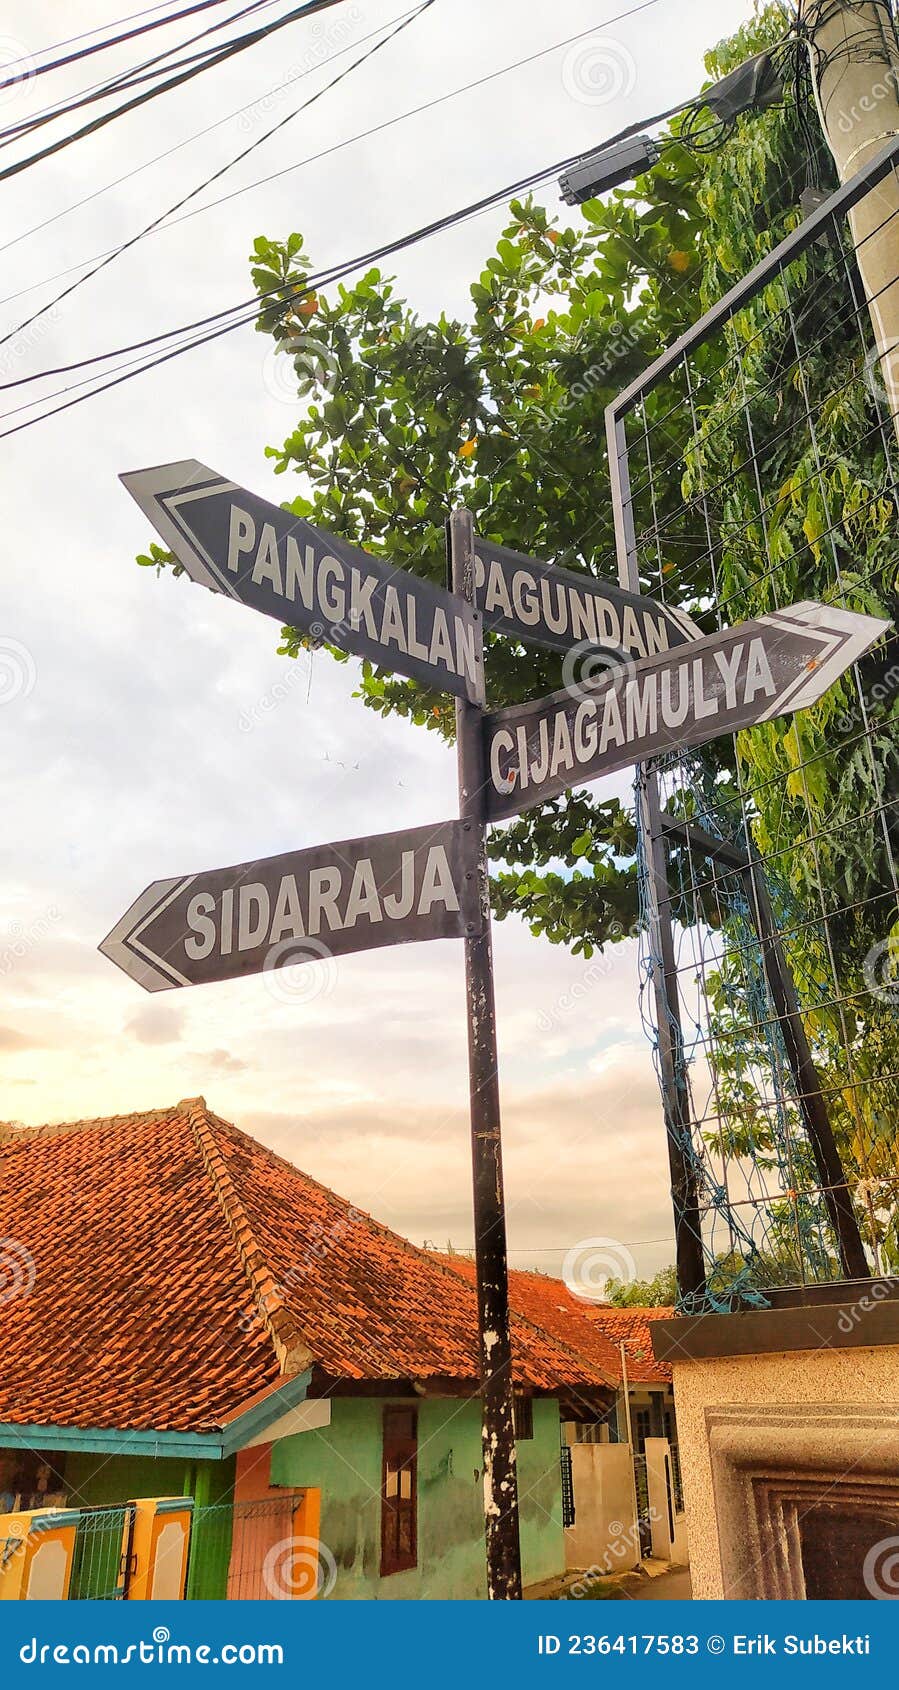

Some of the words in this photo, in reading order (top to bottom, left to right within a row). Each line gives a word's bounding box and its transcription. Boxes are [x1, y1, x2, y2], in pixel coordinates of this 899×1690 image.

[227, 503, 477, 684] PANGKALAN
[490, 637, 777, 796] CIJAGAMULYA
[184, 844, 461, 961] SIDARAJA
